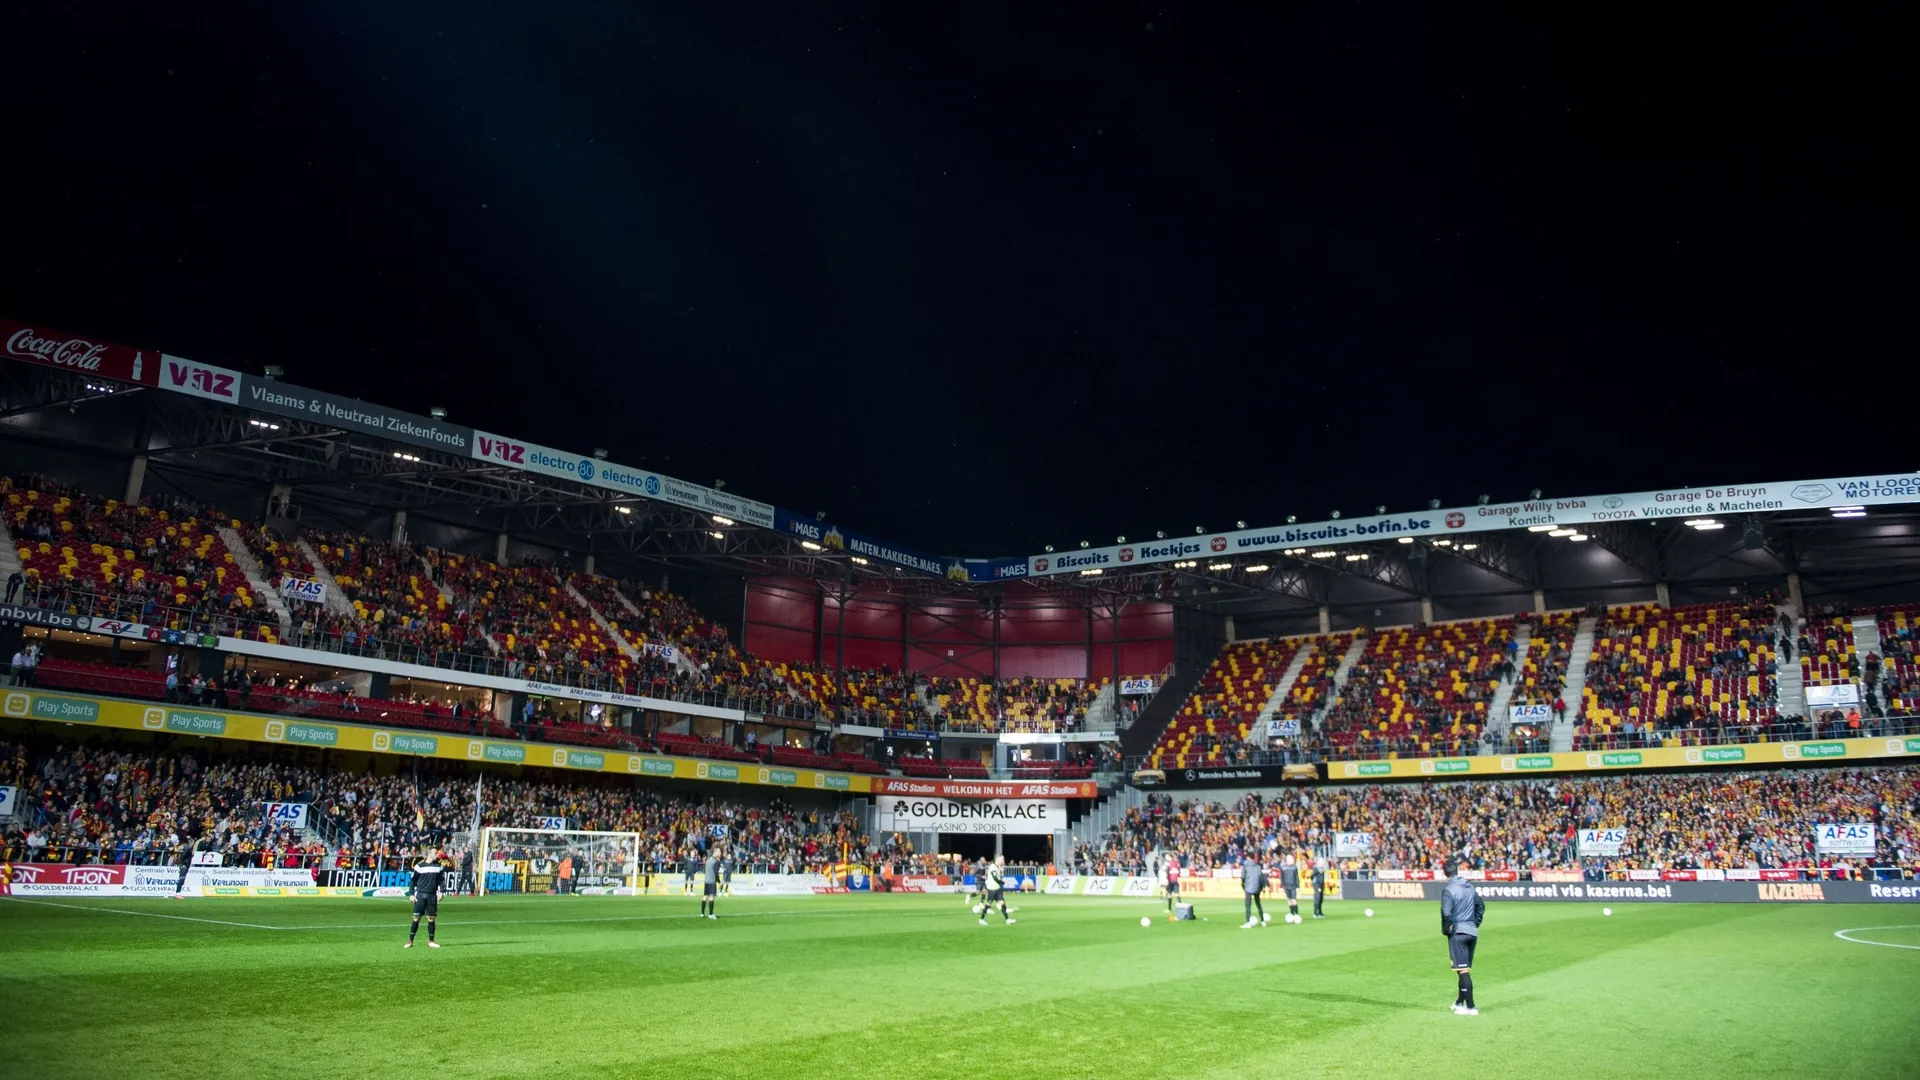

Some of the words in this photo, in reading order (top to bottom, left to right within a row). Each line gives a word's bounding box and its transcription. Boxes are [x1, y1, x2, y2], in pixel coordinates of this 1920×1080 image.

[7, 328, 109, 371] Coca-Cola
[251, 385, 305, 410] Vlaams
[309, 399, 322, 414] &
[325, 403, 385, 429] Neutraal
[387, 417, 465, 447] Ziekenfonds
[530, 452, 575, 472] electro
[579, 462, 594, 478] 80
[602, 469, 643, 487] electro
[646, 478, 659, 494] 80
[1837, 480, 1870, 490] VAN
[1655, 491, 1701, 503] Garage
[1706, 489, 1723, 499] De
[1727, 485, 1767, 498] Bruyn
[1478, 506, 1520, 517] Garage
[1523, 501, 1552, 513] Willy
[1556, 499, 1586, 511] bvba
[1642, 505, 1702, 517] Vilvoorde
[1706, 503, 1715, 513] &
[1720, 498, 1783, 511] Machelen
[1508, 514, 1555, 526] Kontich
[1591, 510, 1636, 520] TOYOTA
[795, 521, 819, 539] MAES
[1237, 518, 1431, 547] www.biscuits-bofin.be
[1141, 543, 1201, 559] Koekjes
[1057, 553, 1109, 568] Biscuits
[1000, 564, 1027, 578] MAES
[285, 578, 323, 595] AFAS
[527, 682, 542, 690] AFAS
[1125, 680, 1149, 689] AFAS
[570, 688, 584, 696] AFAS
[38, 701, 60, 714] Play
[61, 702, 95, 717] Sports
[1515, 705, 1547, 717] AFAS
[172, 715, 191, 727] Play
[192, 716, 222, 730] Sports
[1271, 720, 1298, 730] AFAS
[290, 727, 308, 740] Play
[308, 728, 334, 741] Sports
[395, 737, 410, 749] Play
[411, 738, 434, 751] Sports
[1804, 746, 1819, 756] Play
[1819, 744, 1843, 754] Sports
[487, 745, 501, 757] Play
[502, 747, 523, 758] Sports
[1705, 750, 1719, 759] Play
[1719, 749, 1742, 759] Sports
[570, 753, 583, 765] Play
[583, 755, 602, 766] Sports
[643, 760, 655, 771] Play
[655, 761, 673, 772] Sports
[1518, 759, 1531, 769] Play
[1531, 757, 1551, 767] Sports
[1604, 755, 1618, 765] Play
[1618, 754, 1639, 763] Sports
[887, 781, 909, 792] AFAS
[909, 783, 936, 793] Stadion
[943, 785, 981, 795] WELKOM
[983, 786, 991, 795] IN
[992, 786, 1013, 795] HET
[1021, 784, 1049, 796] AFAS
[1049, 785, 1077, 795] Stadion
[911, 800, 1046, 819] GOLDENPALACE
[931, 821, 967, 832] CASINO
[972, 822, 1007, 833] SPORTS
[1825, 826, 1869, 839] AFAS
[1341, 834, 1373, 845] AFAS
[1586, 831, 1623, 843] AFAS
[61, 867, 119, 884] THON
[1052, 878, 1070, 889] AG
[1089, 879, 1109, 890] AG
[1129, 880, 1149, 891] AG
[1475, 886, 1525, 897] serveer
[1528, 884, 1558, 897] snel
[1560, 884, 1583, 897] via
[1586, 884, 1672, 897] kazerna.be!
[1758, 883, 1825, 900] KAZERNA
